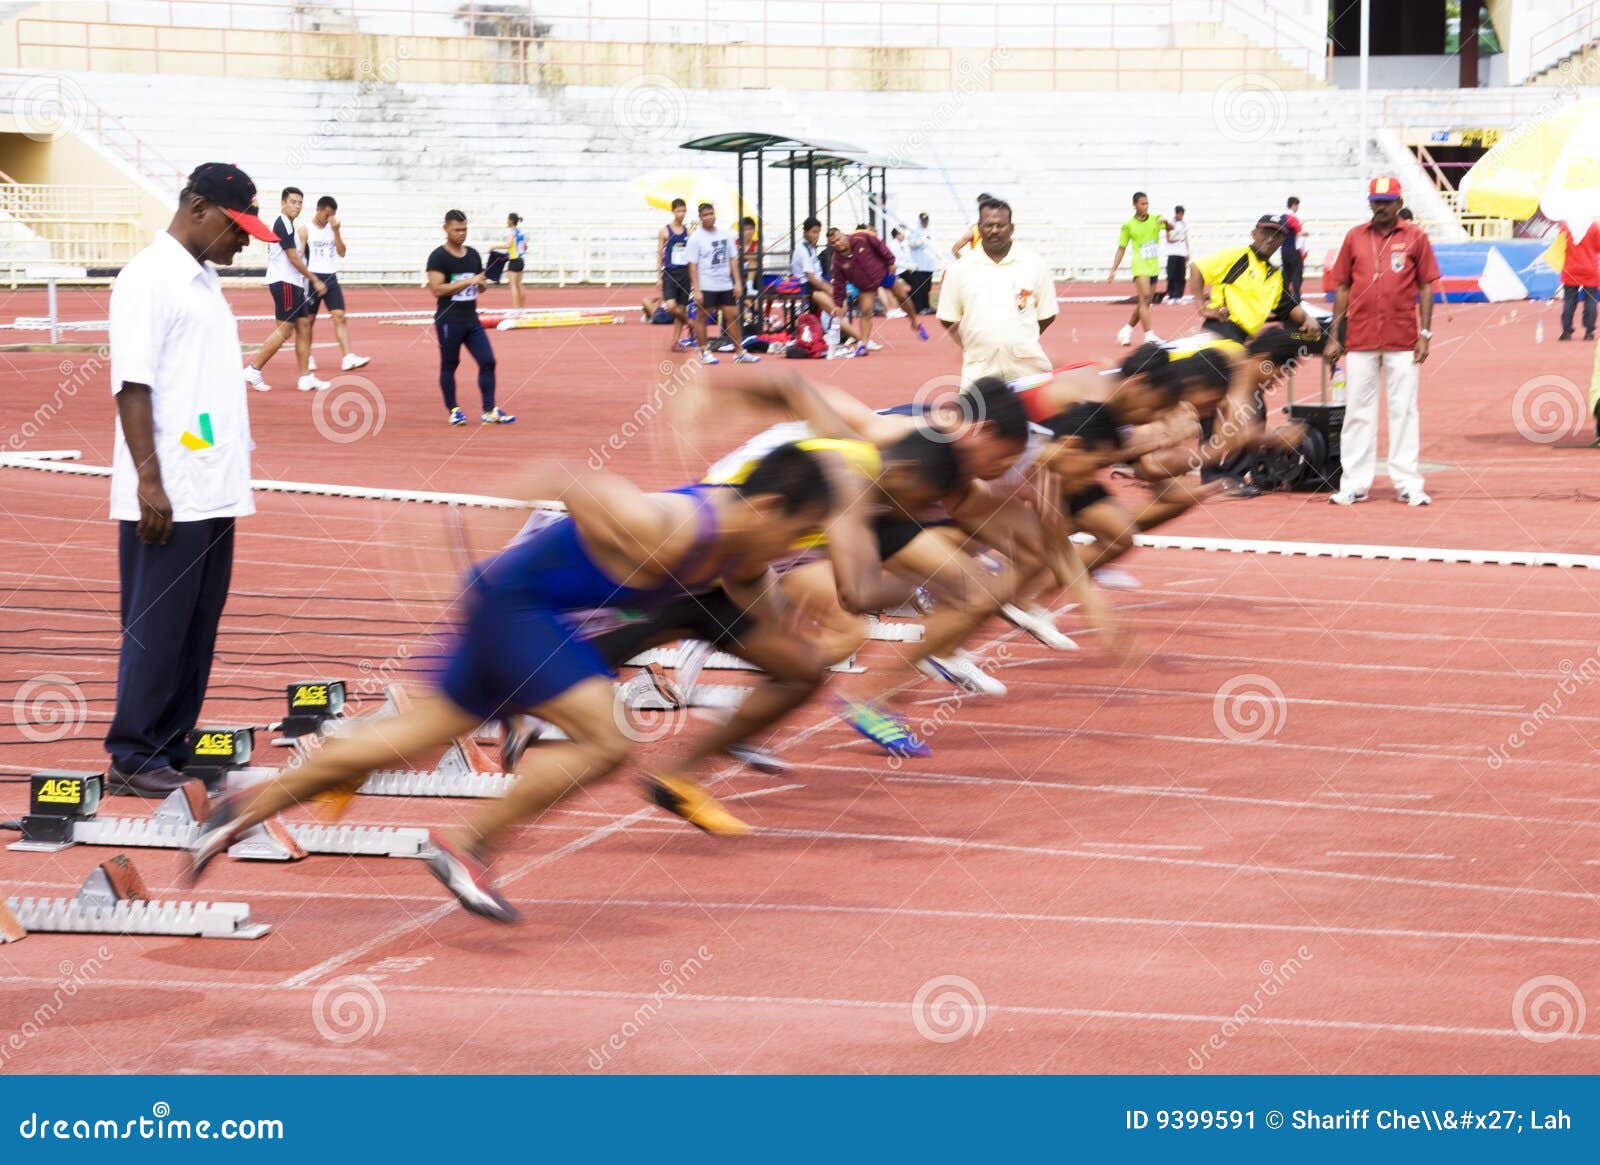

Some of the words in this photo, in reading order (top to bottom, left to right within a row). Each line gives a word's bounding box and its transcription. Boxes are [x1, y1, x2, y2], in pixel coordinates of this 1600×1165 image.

[294, 685, 327, 700] ALGE
[195, 733, 232, 749] ALGE
[38, 779, 80, 796] ALGE
